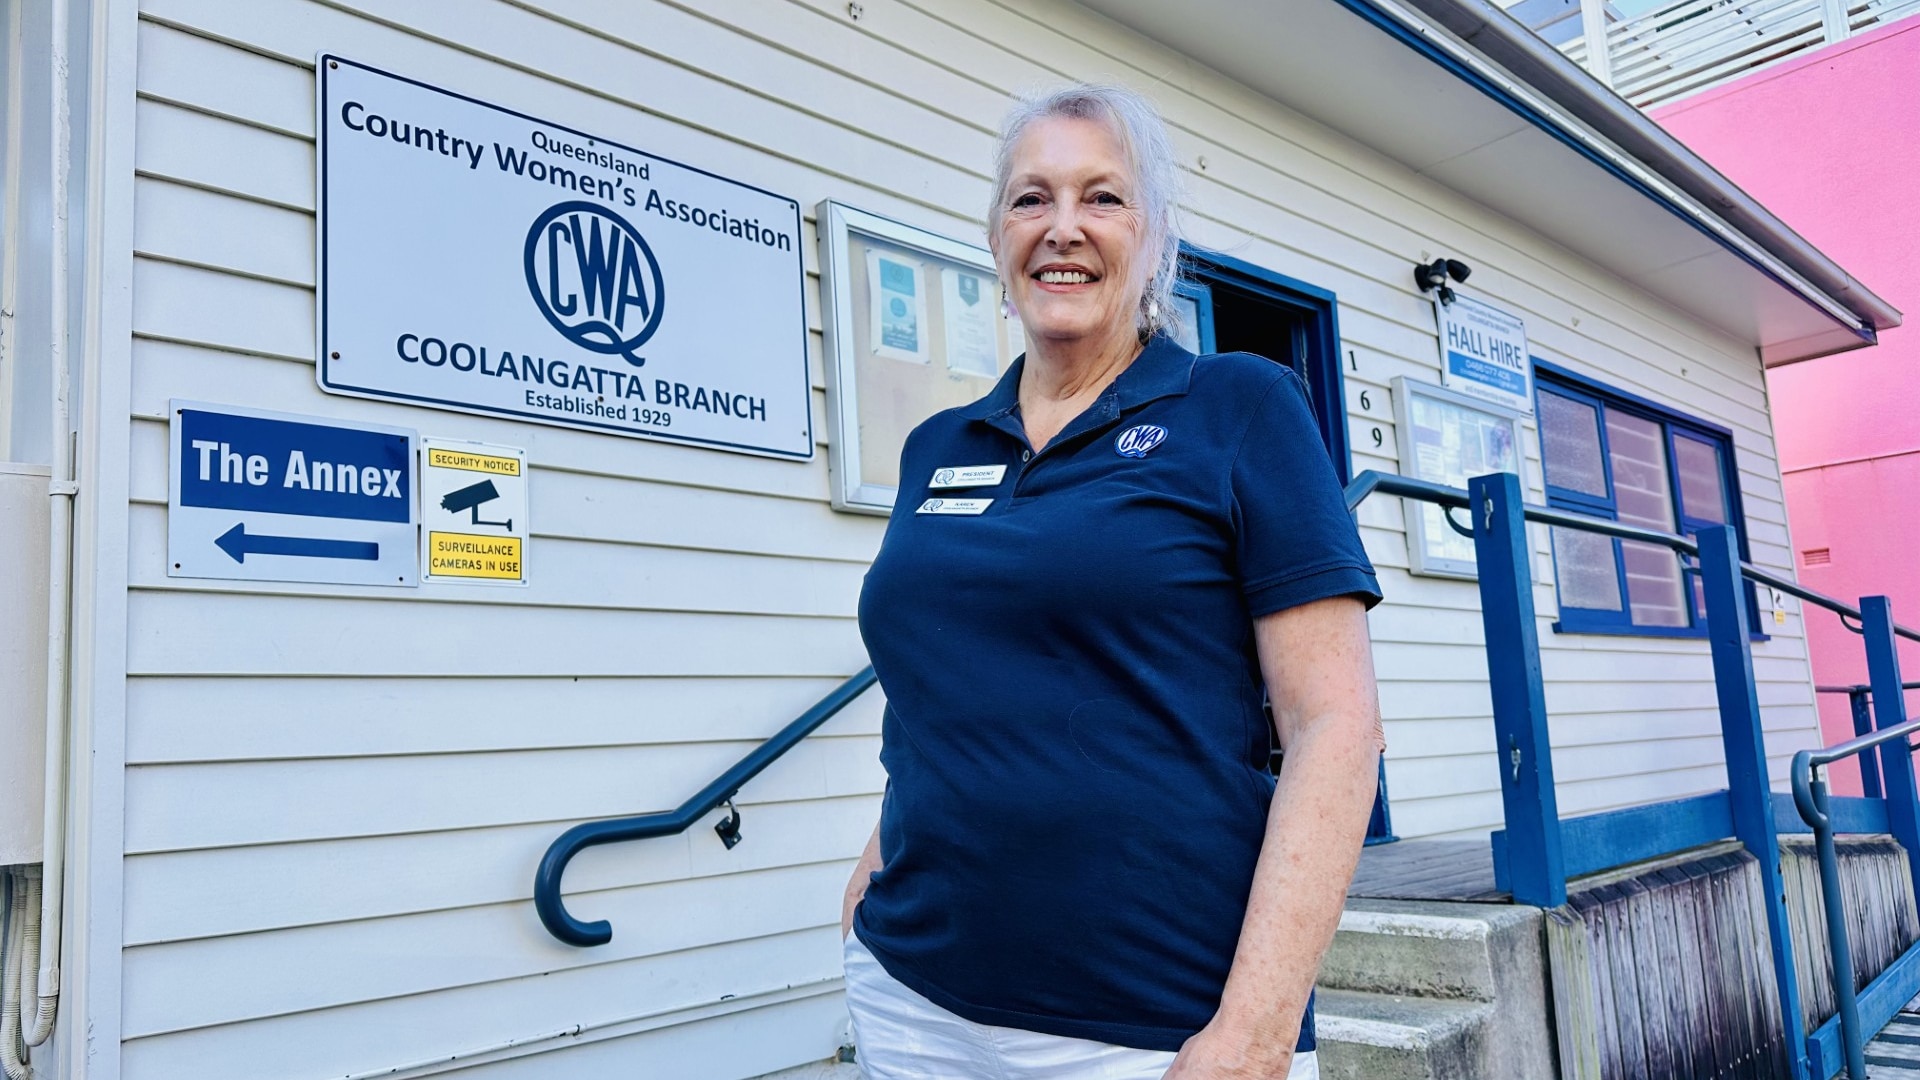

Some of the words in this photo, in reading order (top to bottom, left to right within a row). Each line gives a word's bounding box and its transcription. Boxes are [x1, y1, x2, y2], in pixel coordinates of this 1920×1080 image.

[341, 101, 484, 169] Country
[645, 188, 791, 252] Association
[531, 131, 650, 181] Queensland
[1447, 321, 1487, 357] HALL
[1489, 336, 1523, 370] HIRE
[396, 333, 646, 402] COOLANGATTA
[656, 379, 766, 422] BRANCH
[525, 389, 627, 421] Established
[632, 407, 671, 427] 1929
[192, 439, 269, 487] The
[283, 450, 402, 499] Annex
[435, 454, 481, 469] SECURITY
[483, 460, 516, 472] NOTICE
[432, 558, 482, 571] CAMERAS
[485, 561, 496, 571] IN
[499, 562, 519, 573] USE
[438, 541, 514, 556] SURVEILLANCE
